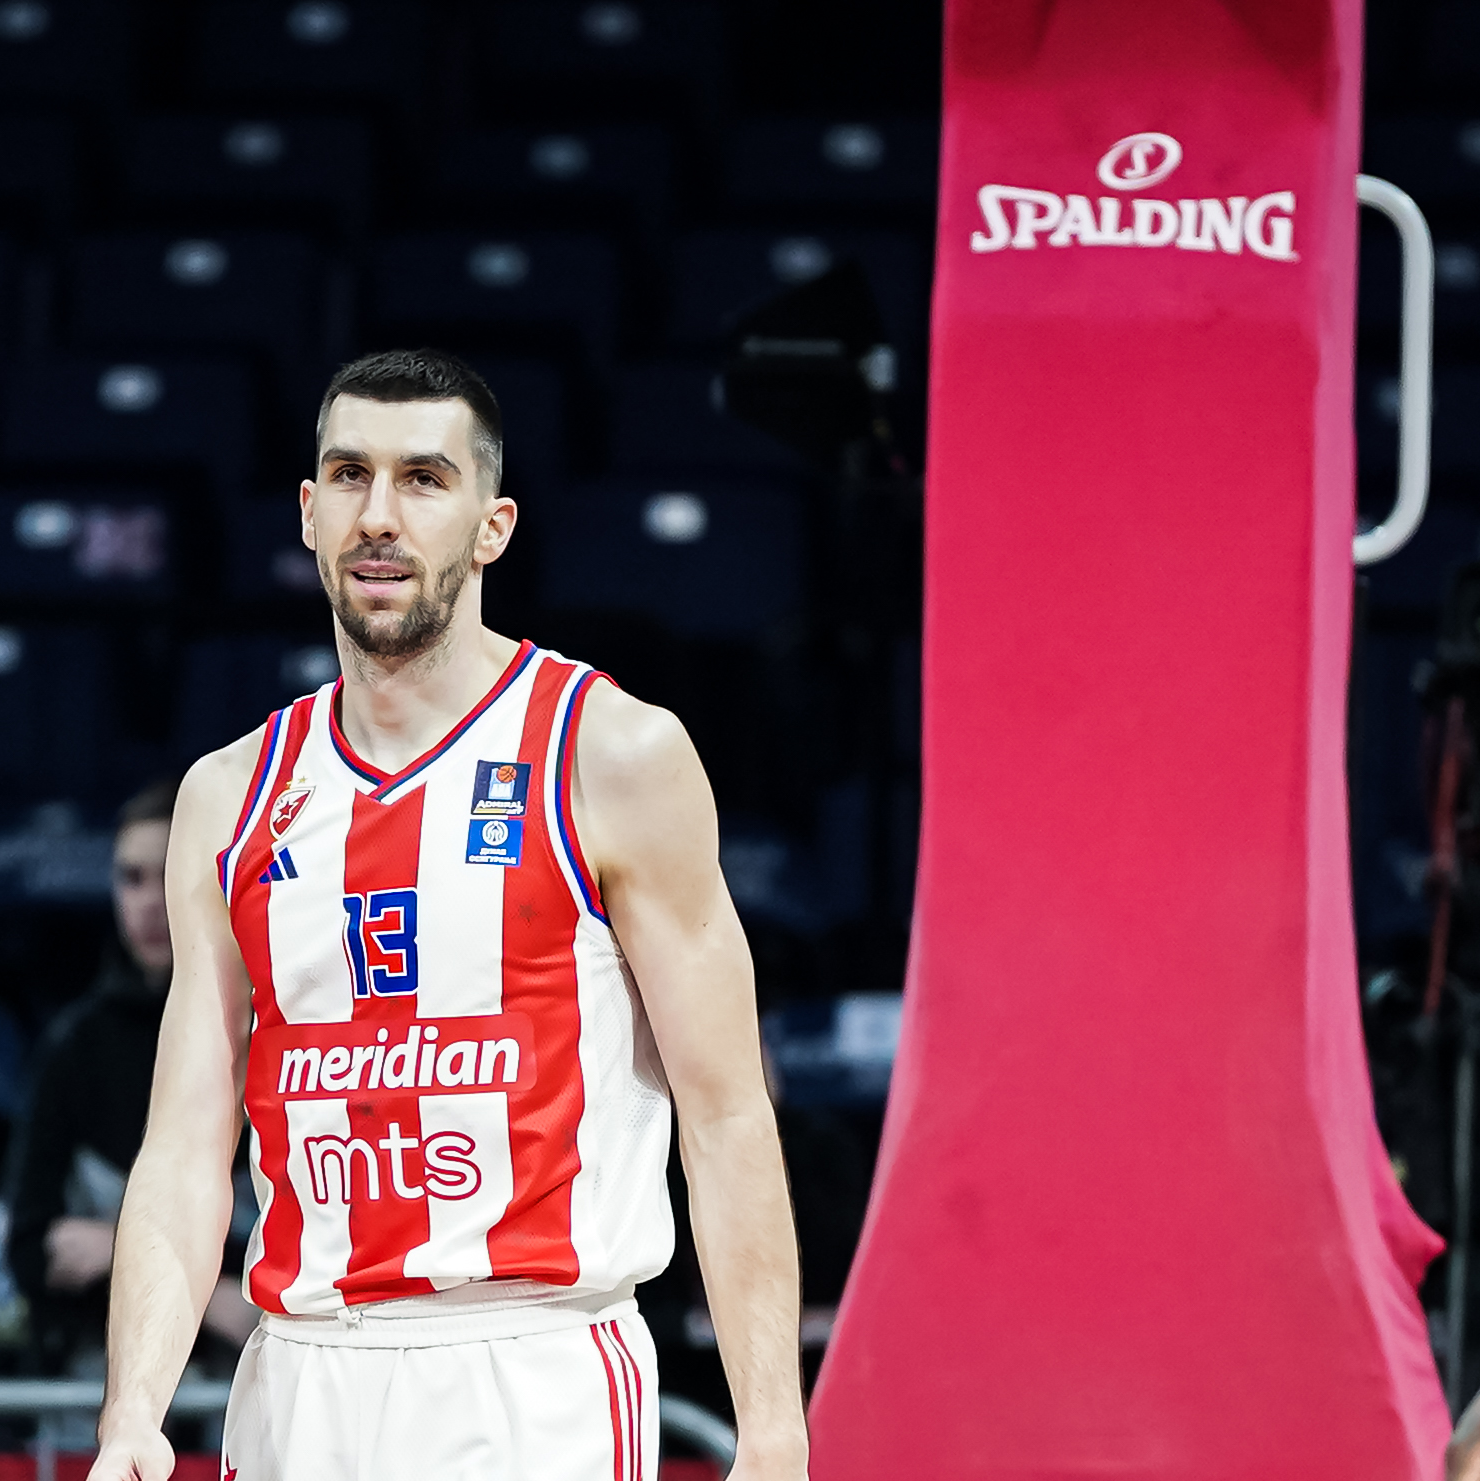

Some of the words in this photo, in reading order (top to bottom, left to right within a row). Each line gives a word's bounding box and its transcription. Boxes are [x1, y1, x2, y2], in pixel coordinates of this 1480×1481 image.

[971, 184, 1300, 262] SPALDING
[342, 888, 419, 998] 13
[277, 1025, 520, 1094] meridian
[304, 1121, 482, 1204] mts
